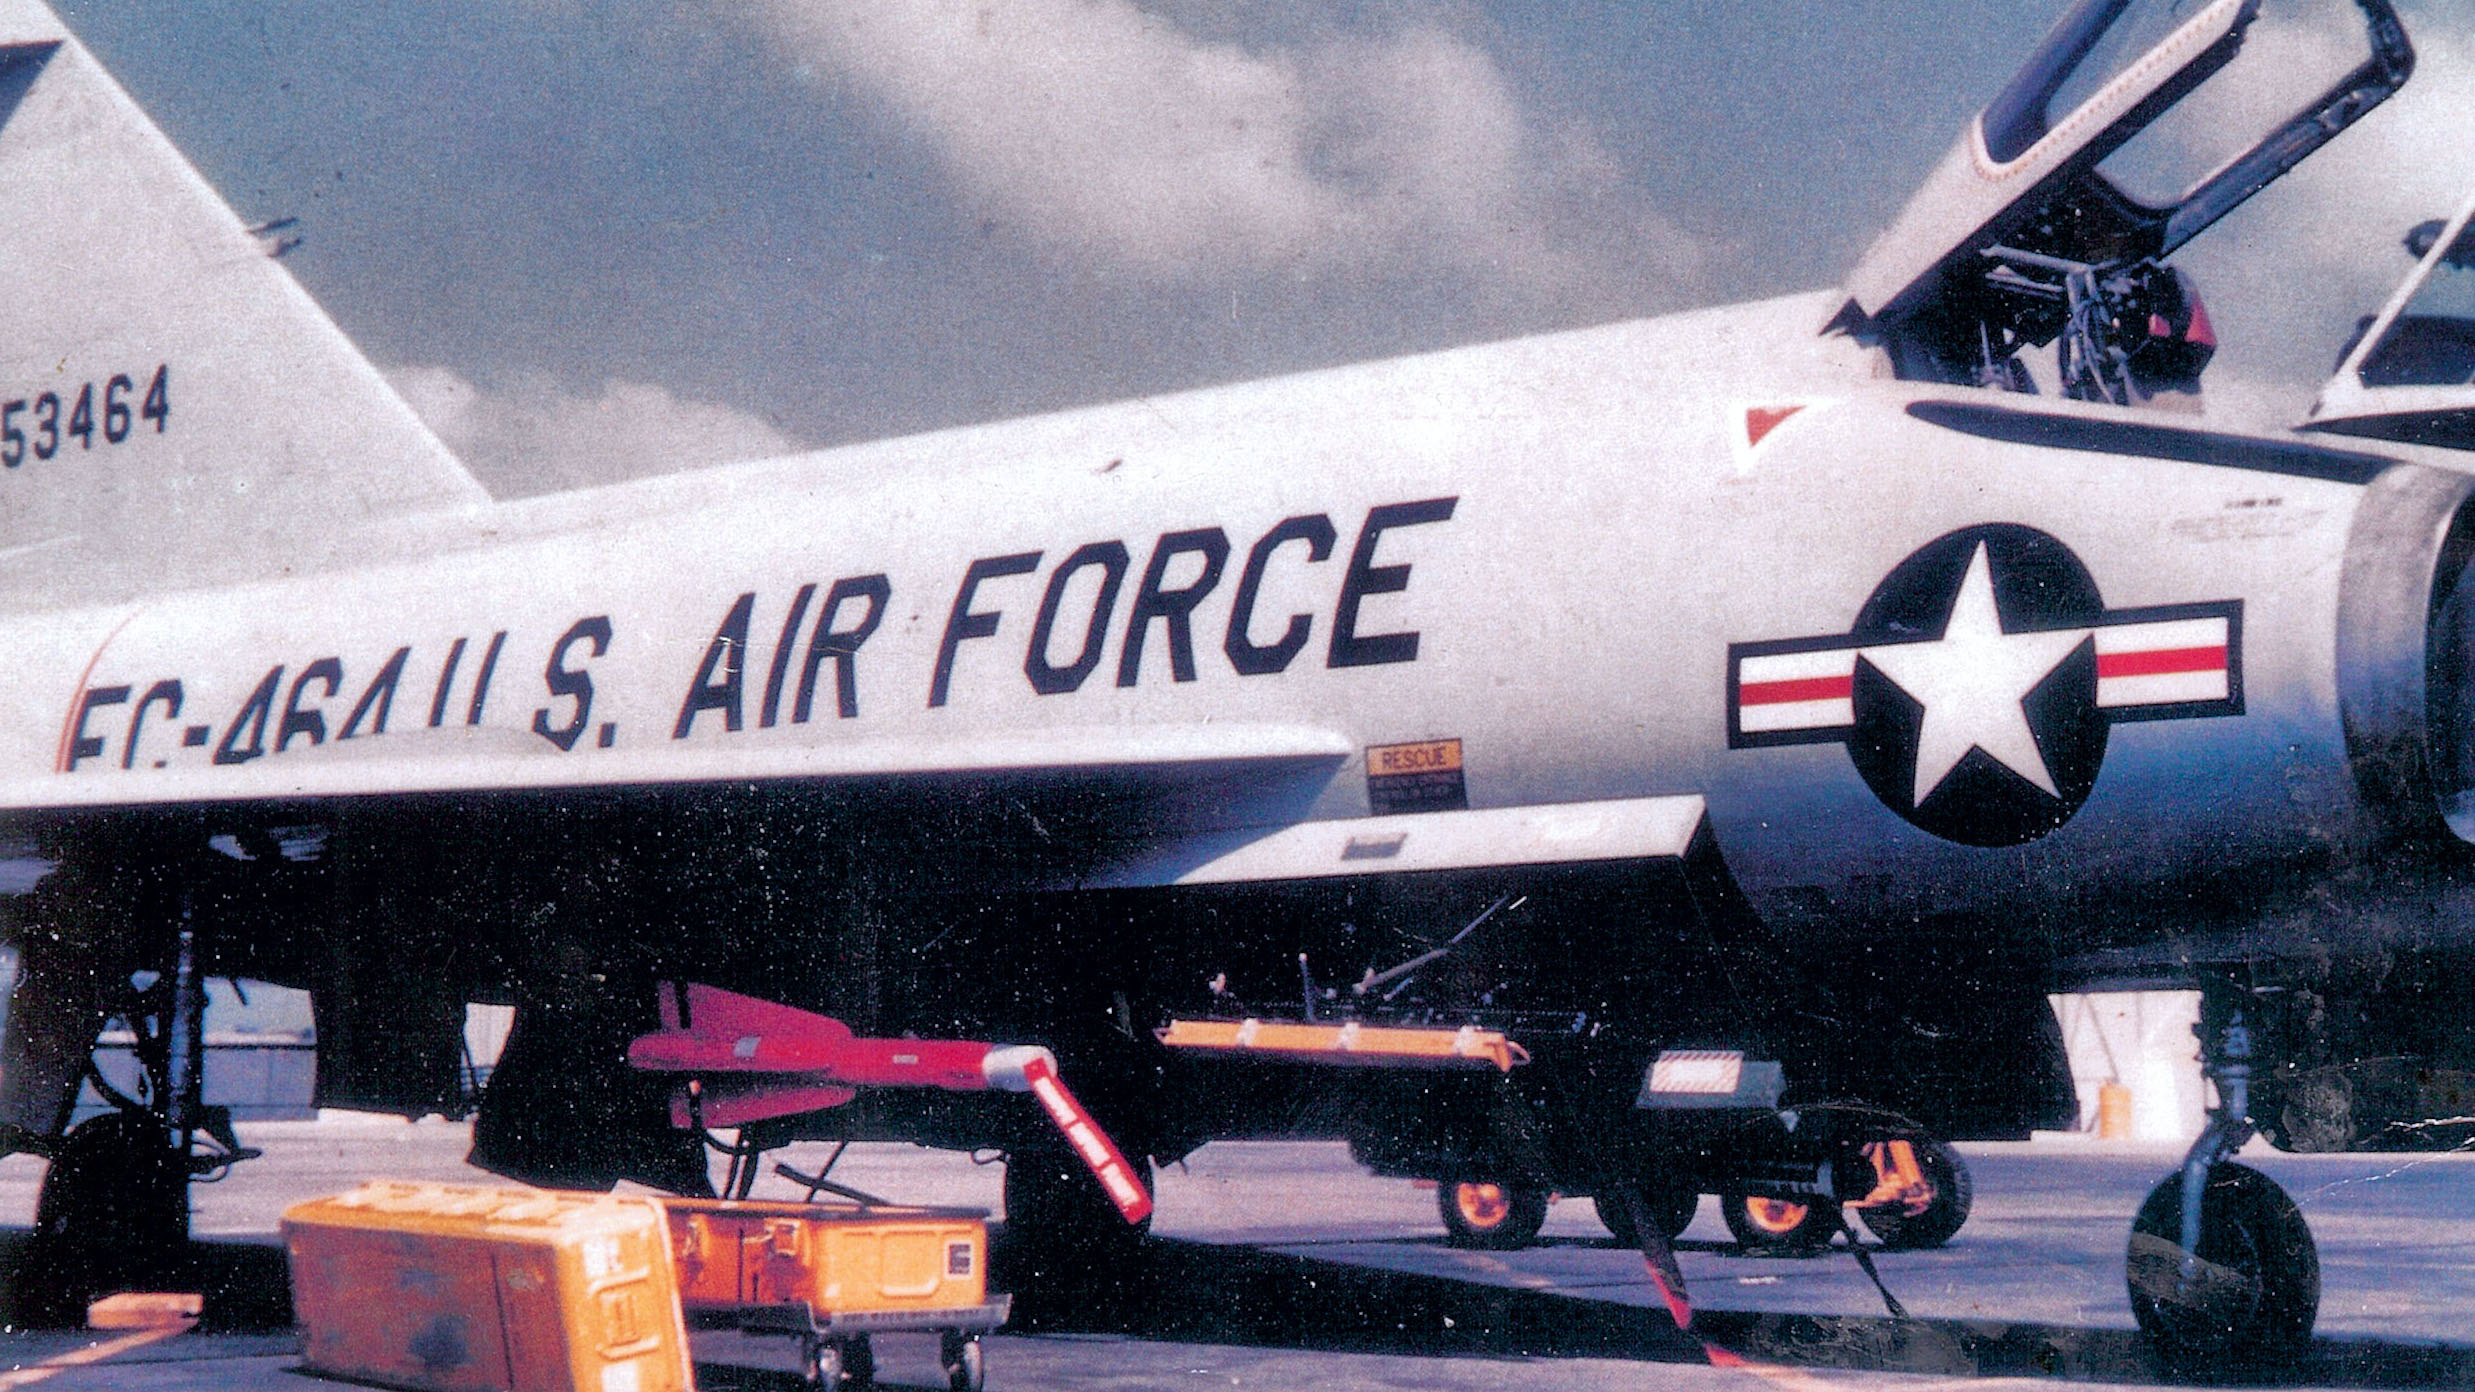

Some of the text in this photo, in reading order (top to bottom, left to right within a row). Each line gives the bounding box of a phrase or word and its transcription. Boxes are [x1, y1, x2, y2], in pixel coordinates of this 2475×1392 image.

[1, 363, 170, 468] 53464
[672, 573, 892, 739] AIR
[927, 495, 1460, 709] FORCE
[1381, 745, 1447, 770] RESCUE
